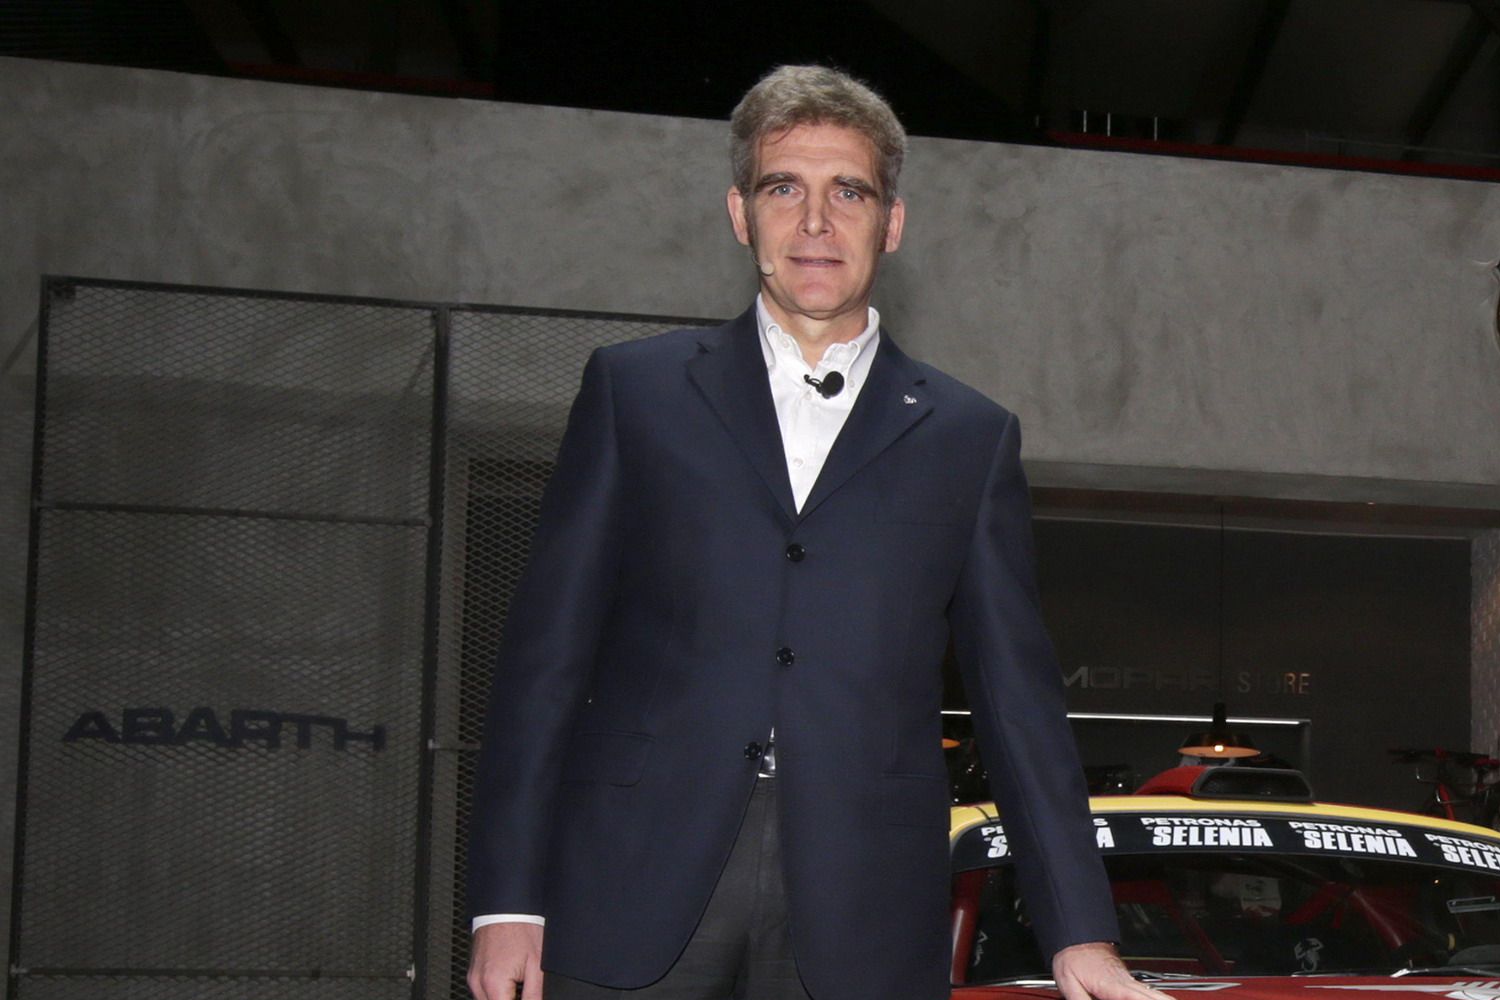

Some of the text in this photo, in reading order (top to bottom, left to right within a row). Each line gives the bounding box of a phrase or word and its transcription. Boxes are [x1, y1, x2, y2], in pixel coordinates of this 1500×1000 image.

[61, 706, 387, 752] ABARTH
[1140, 817, 1261, 827] PETRONAS
[1288, 821, 1402, 837] PETRONAS
[1152, 826, 1274, 847] SELENIA
[1304, 830, 1418, 858] SELENIA
